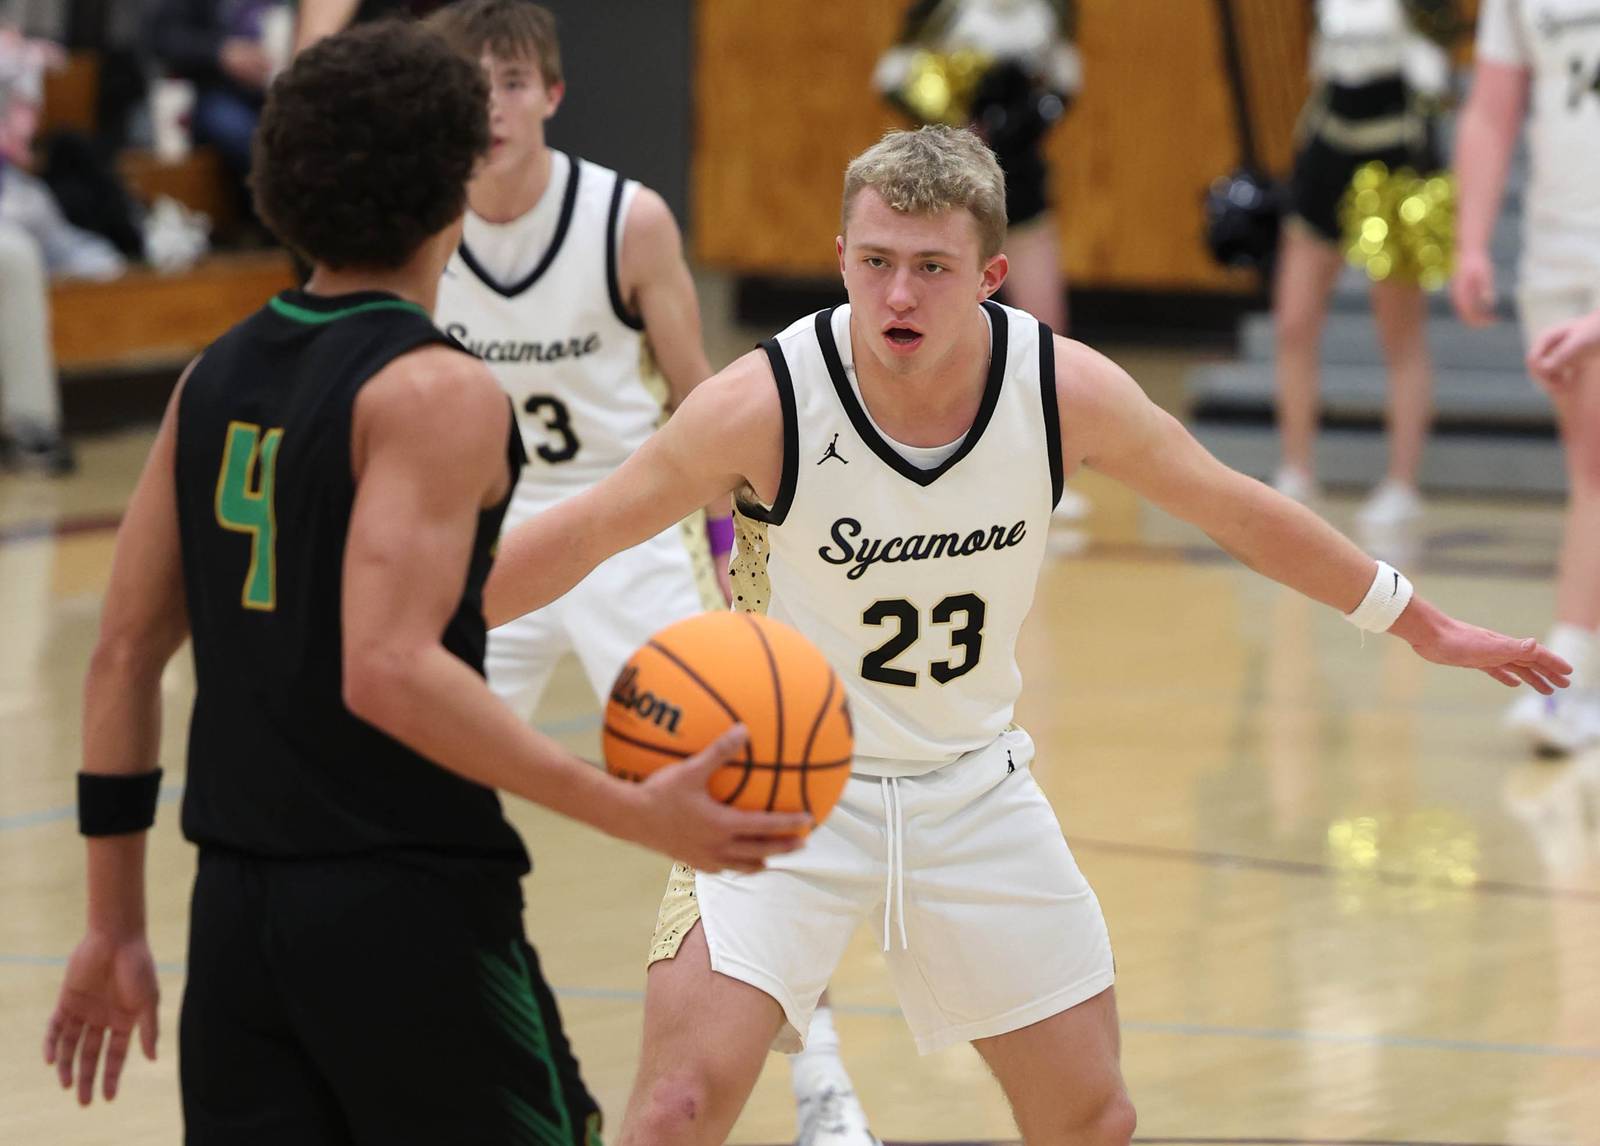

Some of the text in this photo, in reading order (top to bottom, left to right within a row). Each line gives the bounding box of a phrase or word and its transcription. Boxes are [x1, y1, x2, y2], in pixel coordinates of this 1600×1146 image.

[214, 420, 285, 611] 4
[818, 517, 1027, 580] Sycamore
[860, 592, 987, 688] 23
[611, 665, 682, 734] lson
